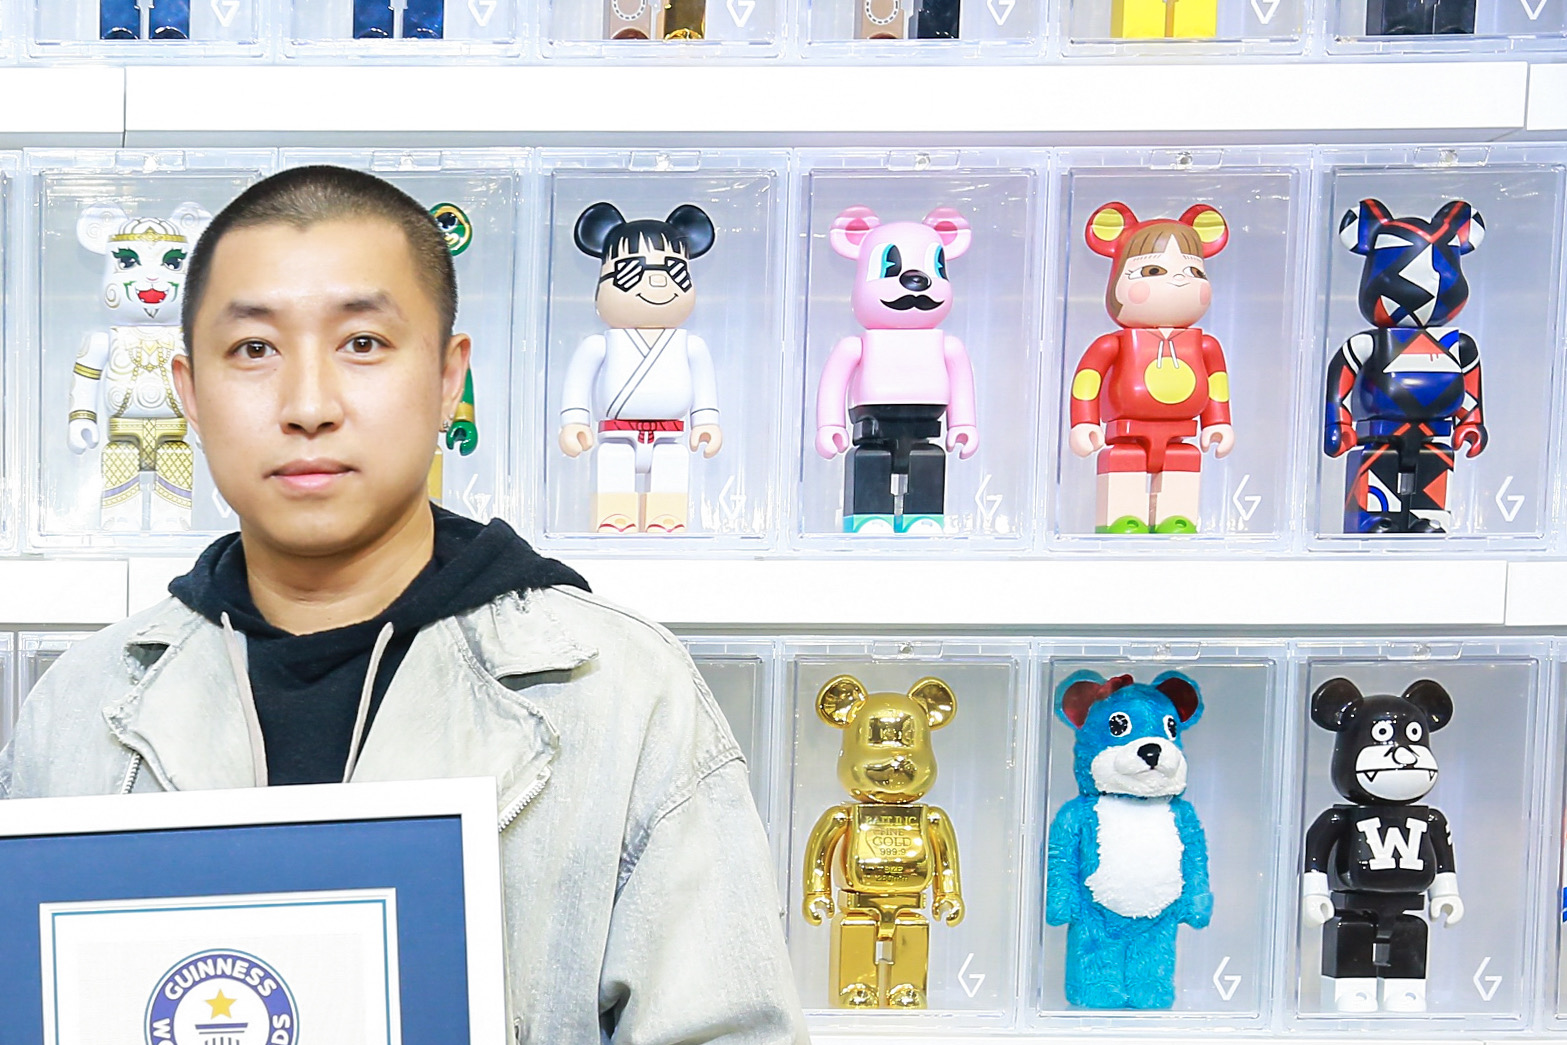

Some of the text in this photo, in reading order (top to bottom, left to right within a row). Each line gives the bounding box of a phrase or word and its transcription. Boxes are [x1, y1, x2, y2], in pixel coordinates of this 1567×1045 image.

[873, 836, 911, 846] GOLD
[1356, 817, 1427, 870] W
[164, 958, 277, 1000] GUINNESS
